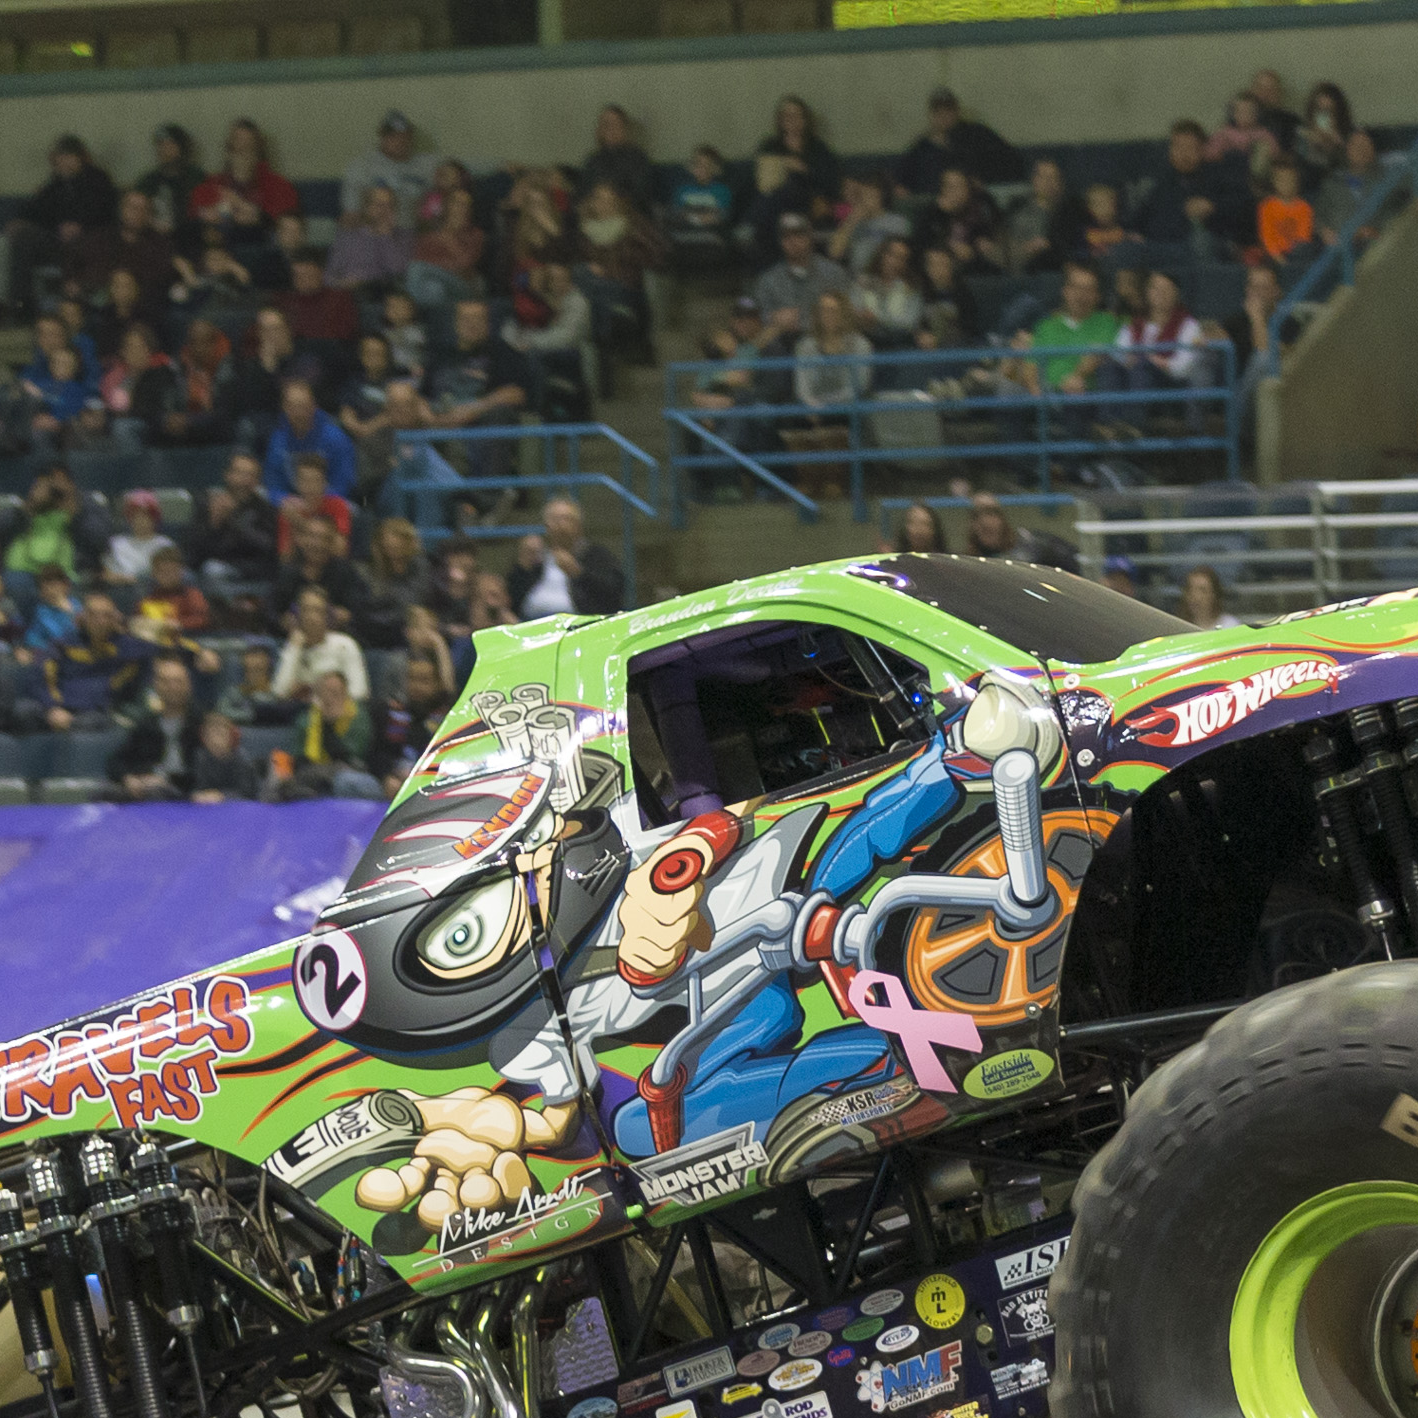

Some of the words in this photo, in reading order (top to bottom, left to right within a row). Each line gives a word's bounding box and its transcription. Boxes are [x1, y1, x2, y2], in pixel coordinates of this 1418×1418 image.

[628, 599, 717, 636] Brandon
[1165, 692, 1236, 745] HOT
[1227, 660, 1333, 725] WHEELS
[451, 771, 546, 860] KENDON
[303, 943, 361, 1019] 2
[981, 1052, 1030, 1076] Eastside
[1001, 1063, 1034, 1079] Storage
[106, 1049, 220, 1130] FAST
[845, 1090, 877, 1113] KSR
[840, 1103, 894, 1126] MOTORSPORTS
[638, 1142, 765, 1200] MONSTER
[687, 1173, 741, 1203] JAM
[439, 1206, 506, 1254] Mike
[439, 1204, 602, 1274] DESIGN
[916, 1274, 958, 1293] LITTLEFIELD
[881, 1340, 963, 1403] NMF
[784, 1399, 814, 1417] ROD
[890, 1381, 954, 1410] GoNMF.com
